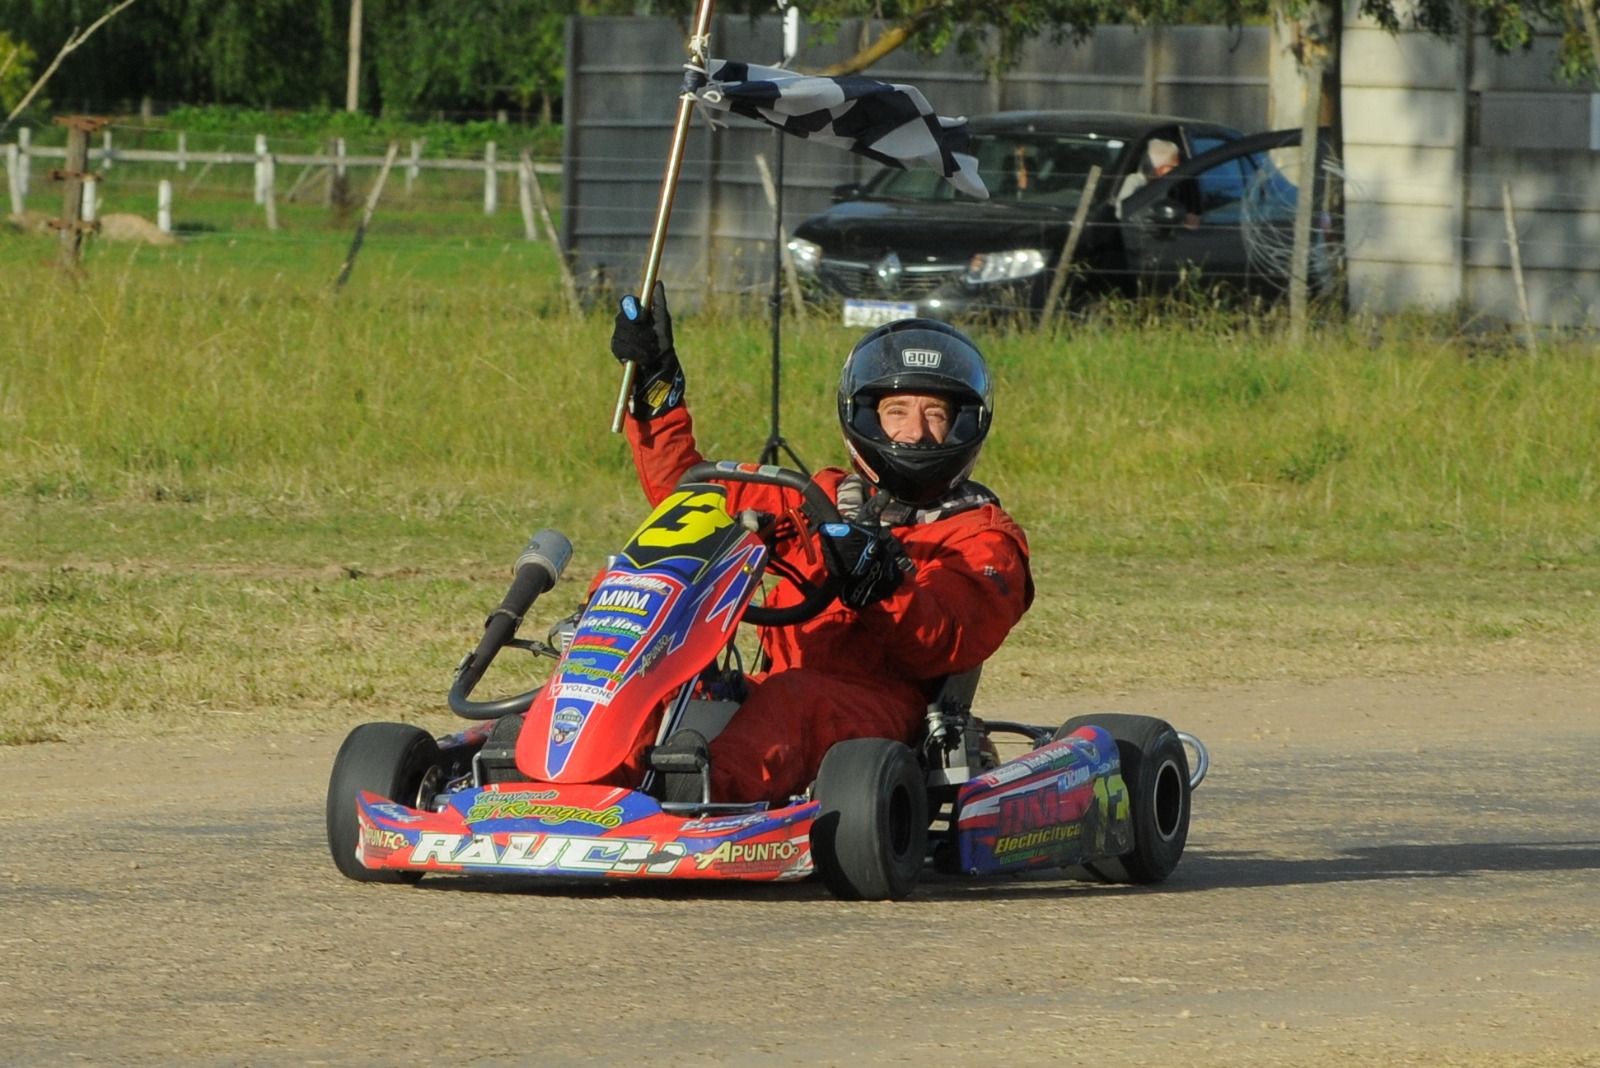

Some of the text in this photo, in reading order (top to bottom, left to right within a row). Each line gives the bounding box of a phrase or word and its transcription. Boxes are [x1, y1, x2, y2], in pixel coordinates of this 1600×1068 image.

[907, 351, 938, 366] agv
[597, 590, 651, 610] MWM
[565, 684, 614, 699] VOLZONE
[695, 840, 799, 870] APUNTO
